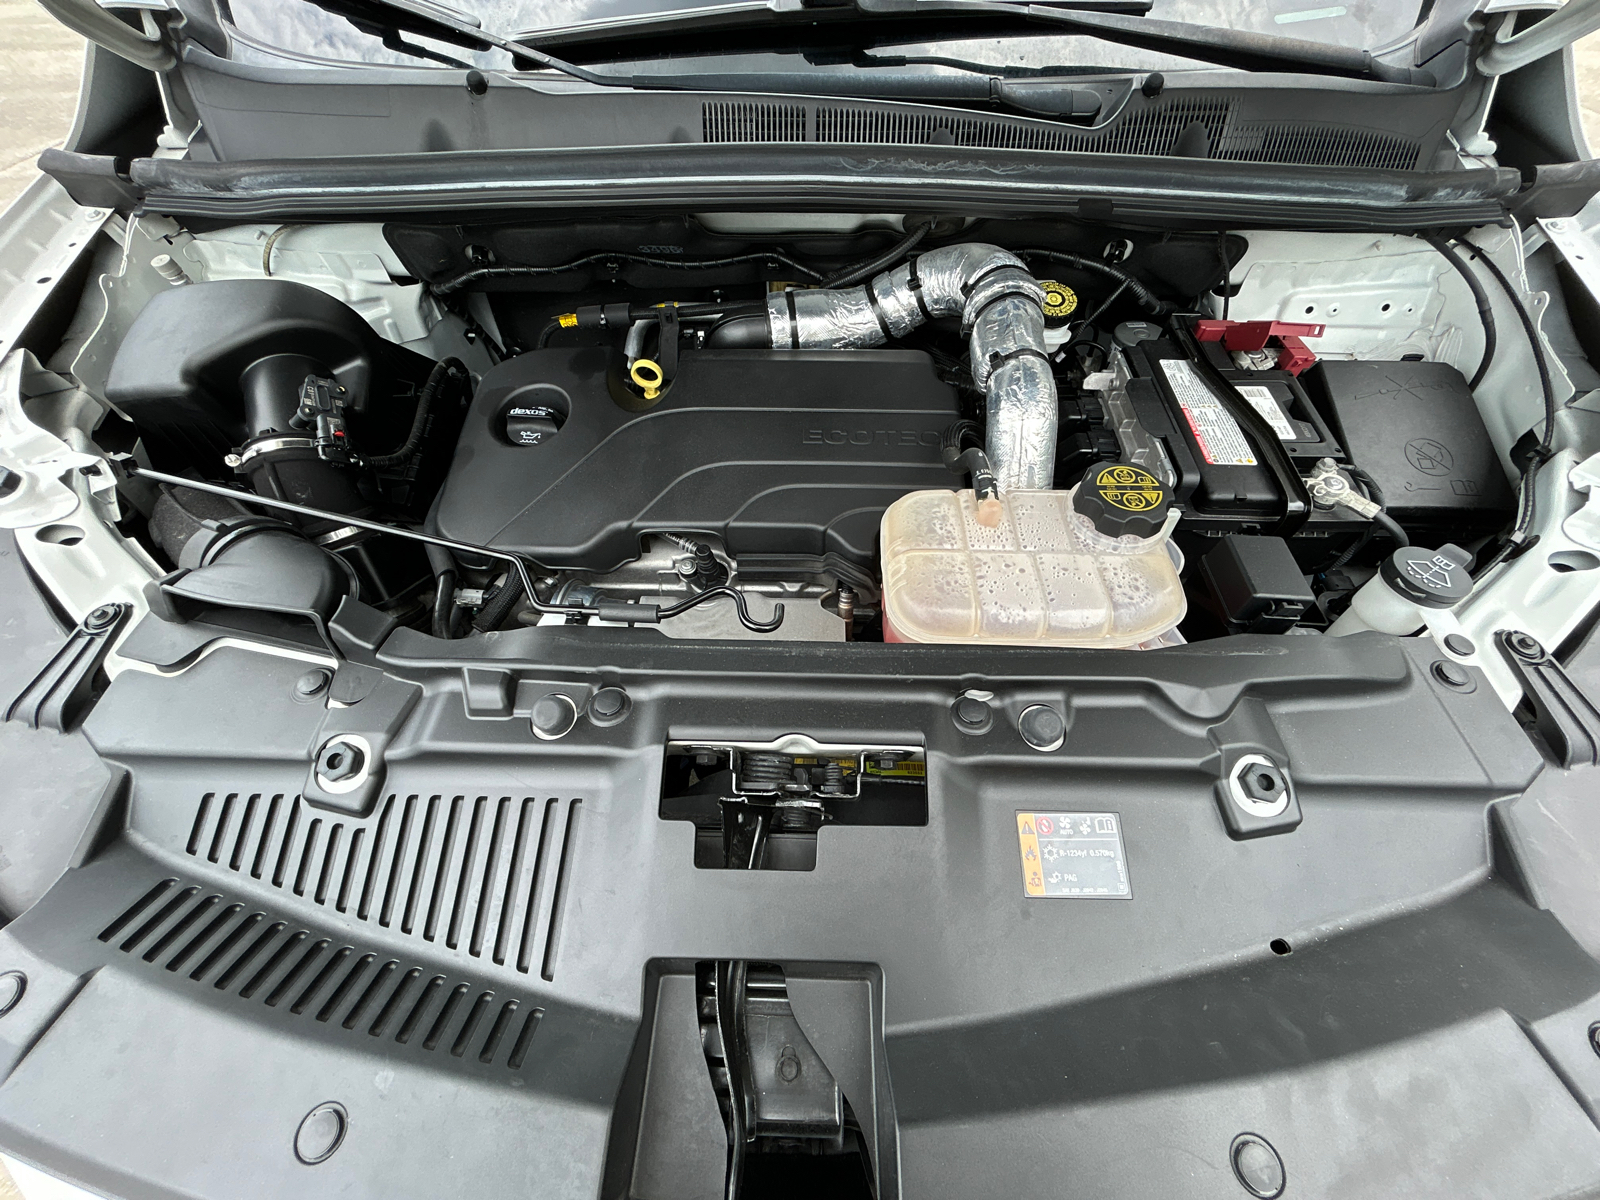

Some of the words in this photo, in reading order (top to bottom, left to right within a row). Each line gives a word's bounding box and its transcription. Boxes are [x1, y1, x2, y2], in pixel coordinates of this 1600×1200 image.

[510, 407, 546, 416] dexos
[802, 429, 942, 447] ECOTEC
[1063, 873, 1078, 882] PAG
